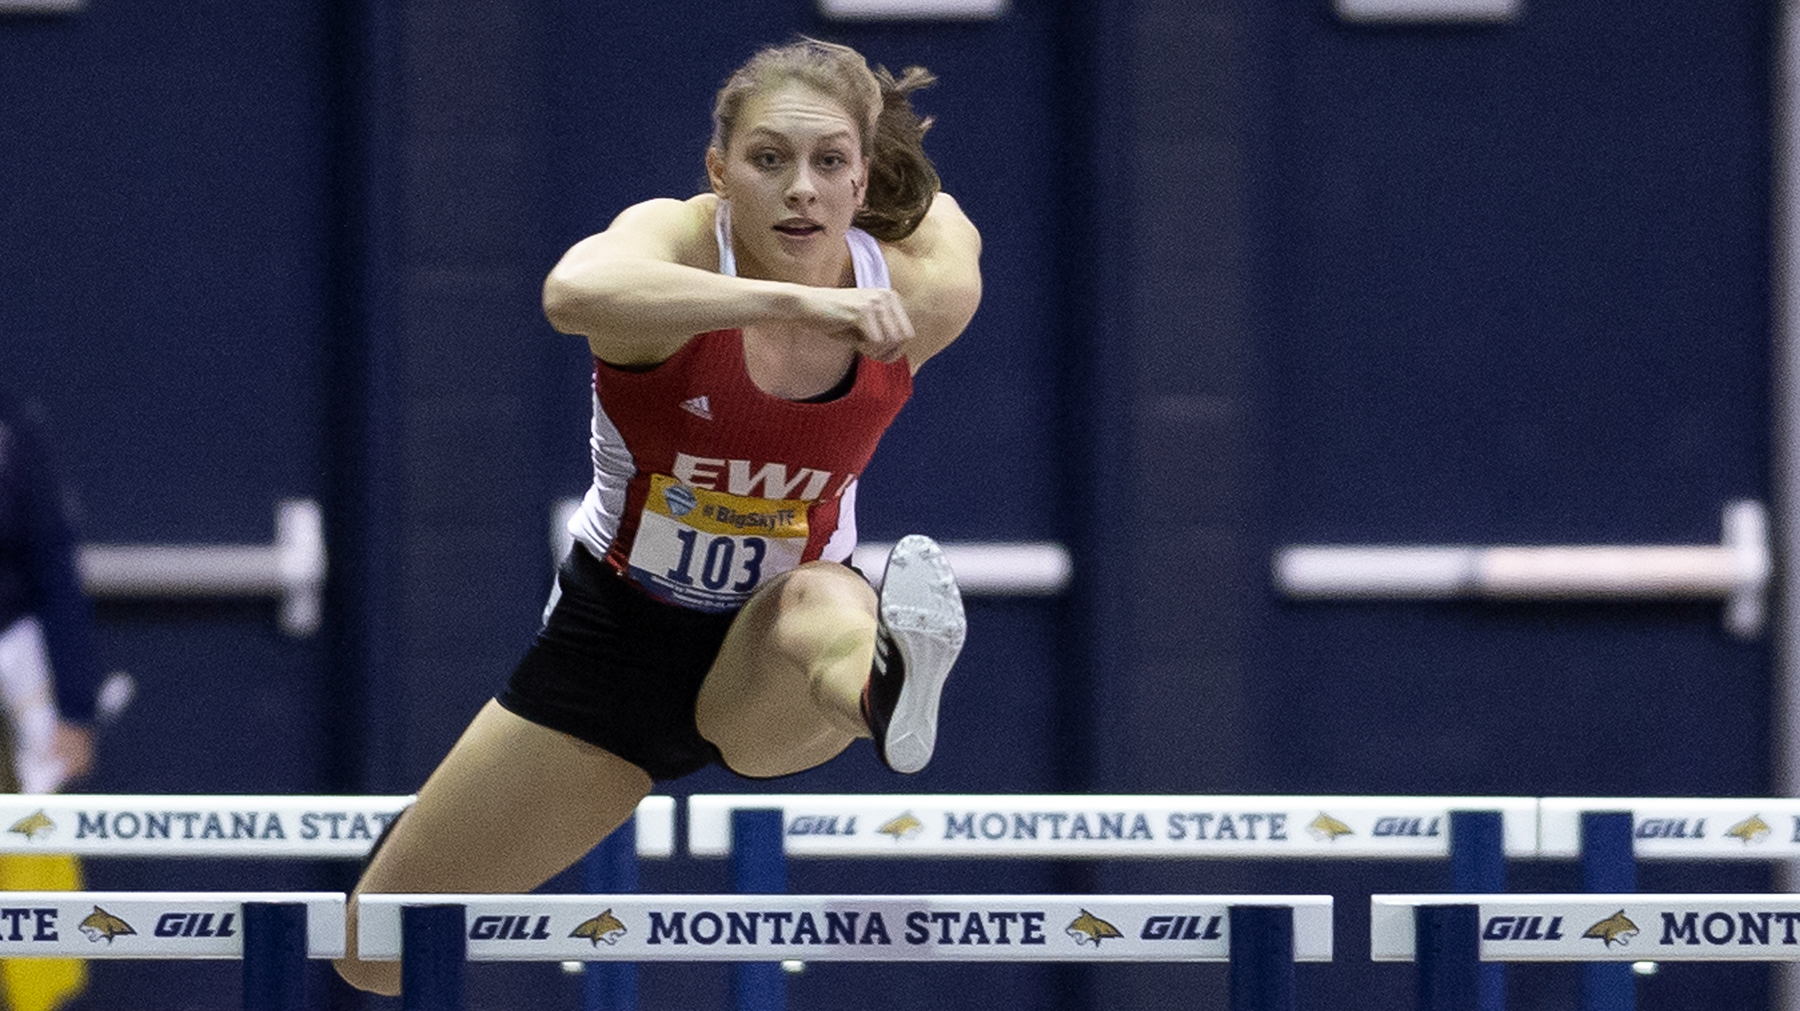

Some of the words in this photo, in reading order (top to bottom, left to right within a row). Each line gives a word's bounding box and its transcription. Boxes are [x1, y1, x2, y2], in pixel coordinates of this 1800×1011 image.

[667, 528, 767, 593] 103
[75, 812, 286, 840] MONTANA
[300, 812, 401, 840] STAT
[787, 815, 858, 836] GILL
[943, 812, 1154, 841] MONTANA
[1167, 812, 1288, 841] STATE
[1372, 817, 1441, 837] GILL
[1636, 819, 1706, 839] GILL
[0, 908, 59, 941] TE
[153, 913, 236, 938] GILL
[469, 915, 551, 941] GILL
[646, 911, 893, 945] MONTANA
[905, 911, 1046, 945] STATE
[1140, 915, 1222, 941] GILL
[1482, 916, 1563, 941] GILL
[1660, 911, 1800, 945] MONT
